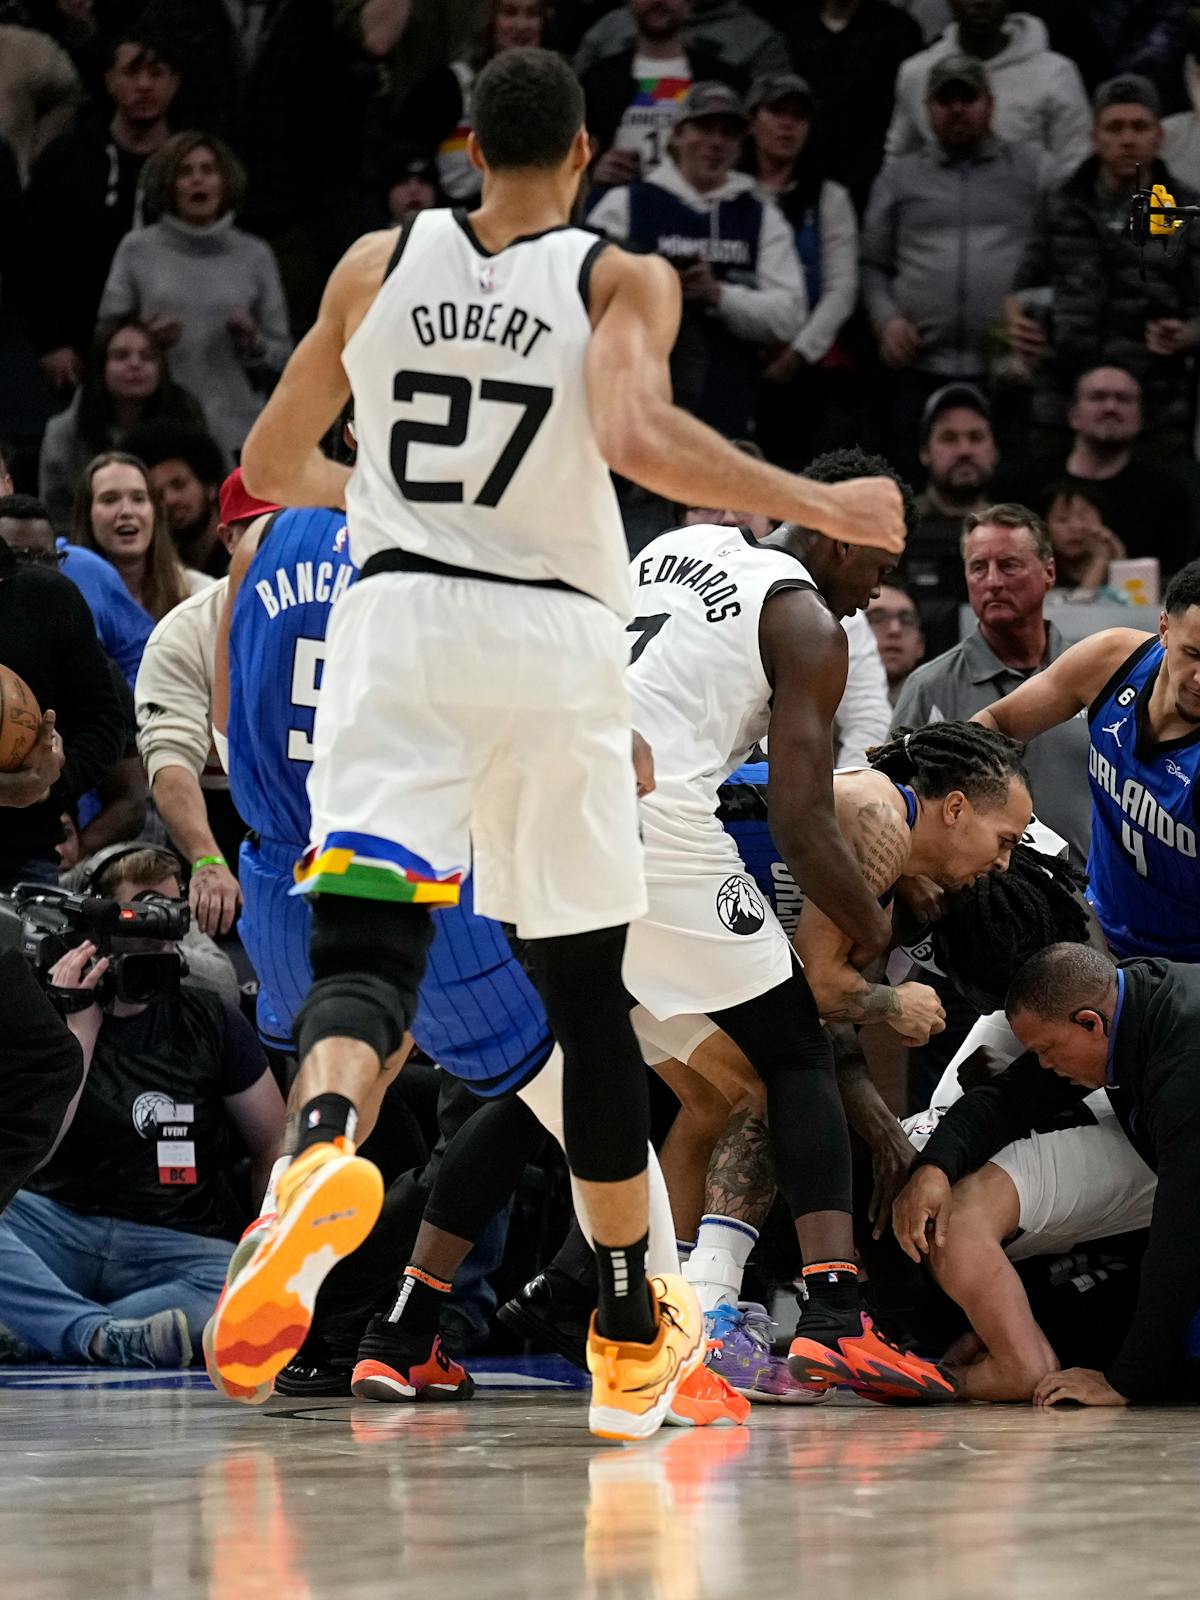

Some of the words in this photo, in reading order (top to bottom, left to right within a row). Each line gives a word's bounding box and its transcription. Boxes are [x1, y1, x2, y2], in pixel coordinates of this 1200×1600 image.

[411, 301, 552, 358] GOBERT
[389, 369, 554, 508] 27
[638, 554, 742, 623] EDWARDS
[1117, 687, 1136, 706] 6
[1088, 743, 1198, 859] ORLANDO
[1164, 758, 1192, 788] Disney
[1121, 818, 1148, 879] 4
[162, 1125, 188, 1137] EVENT
